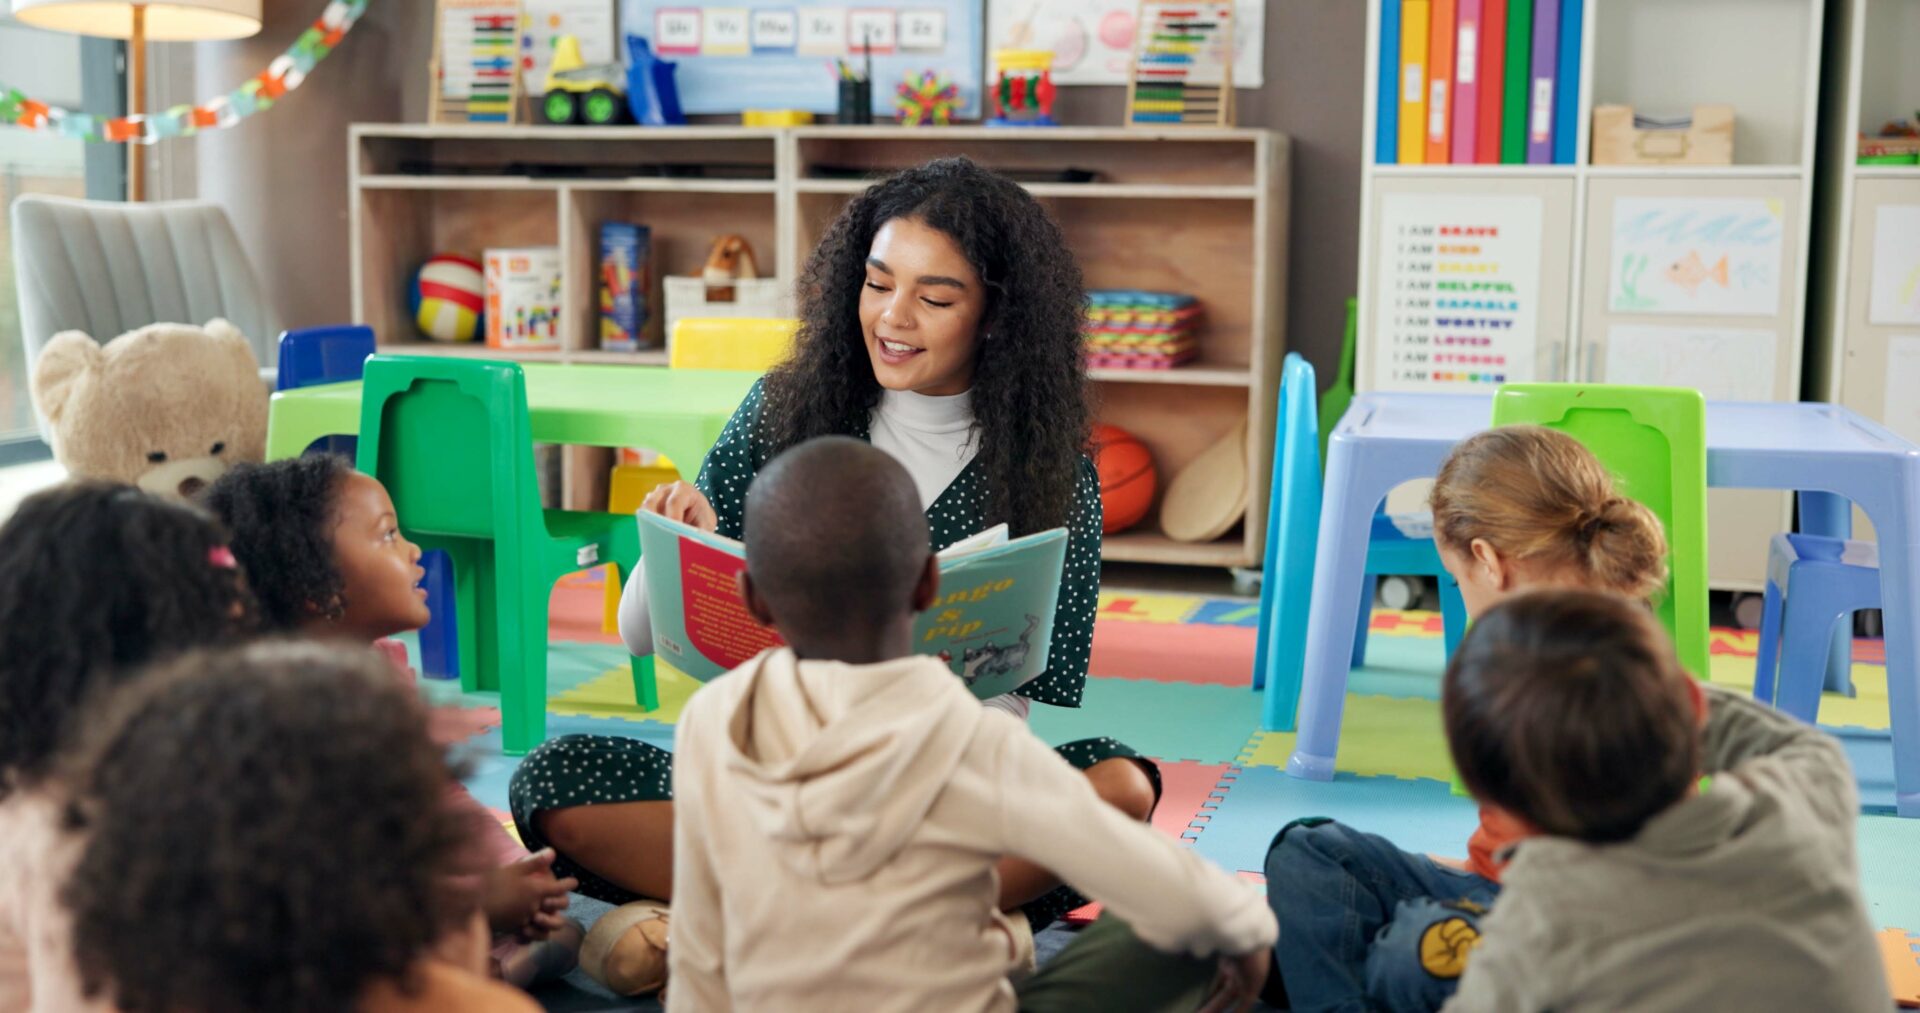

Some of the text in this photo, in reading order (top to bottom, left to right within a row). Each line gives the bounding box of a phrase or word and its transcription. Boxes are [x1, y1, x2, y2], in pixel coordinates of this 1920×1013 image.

[1410, 226, 1434, 236] AM
[1439, 226, 1498, 237] BRAVE
[1409, 244, 1433, 254] AM
[1438, 244, 1481, 255] KIND
[1408, 262, 1432, 272] AM
[1438, 262, 1498, 273] SMART
[1407, 281, 1431, 291] AM
[1436, 281, 1515, 292] HELPFUL
[1406, 299, 1430, 309] AM
[1436, 299, 1518, 311] CAPABLE
[1405, 318, 1429, 328] AM
[1436, 318, 1514, 329] WORTHY
[1405, 335, 1428, 346] AM
[1434, 335, 1491, 346] LOVED
[1405, 353, 1428, 363] AM
[1434, 353, 1506, 365] STRONG
[1404, 371, 1427, 381] AM
[931, 577, 1014, 607] ango
